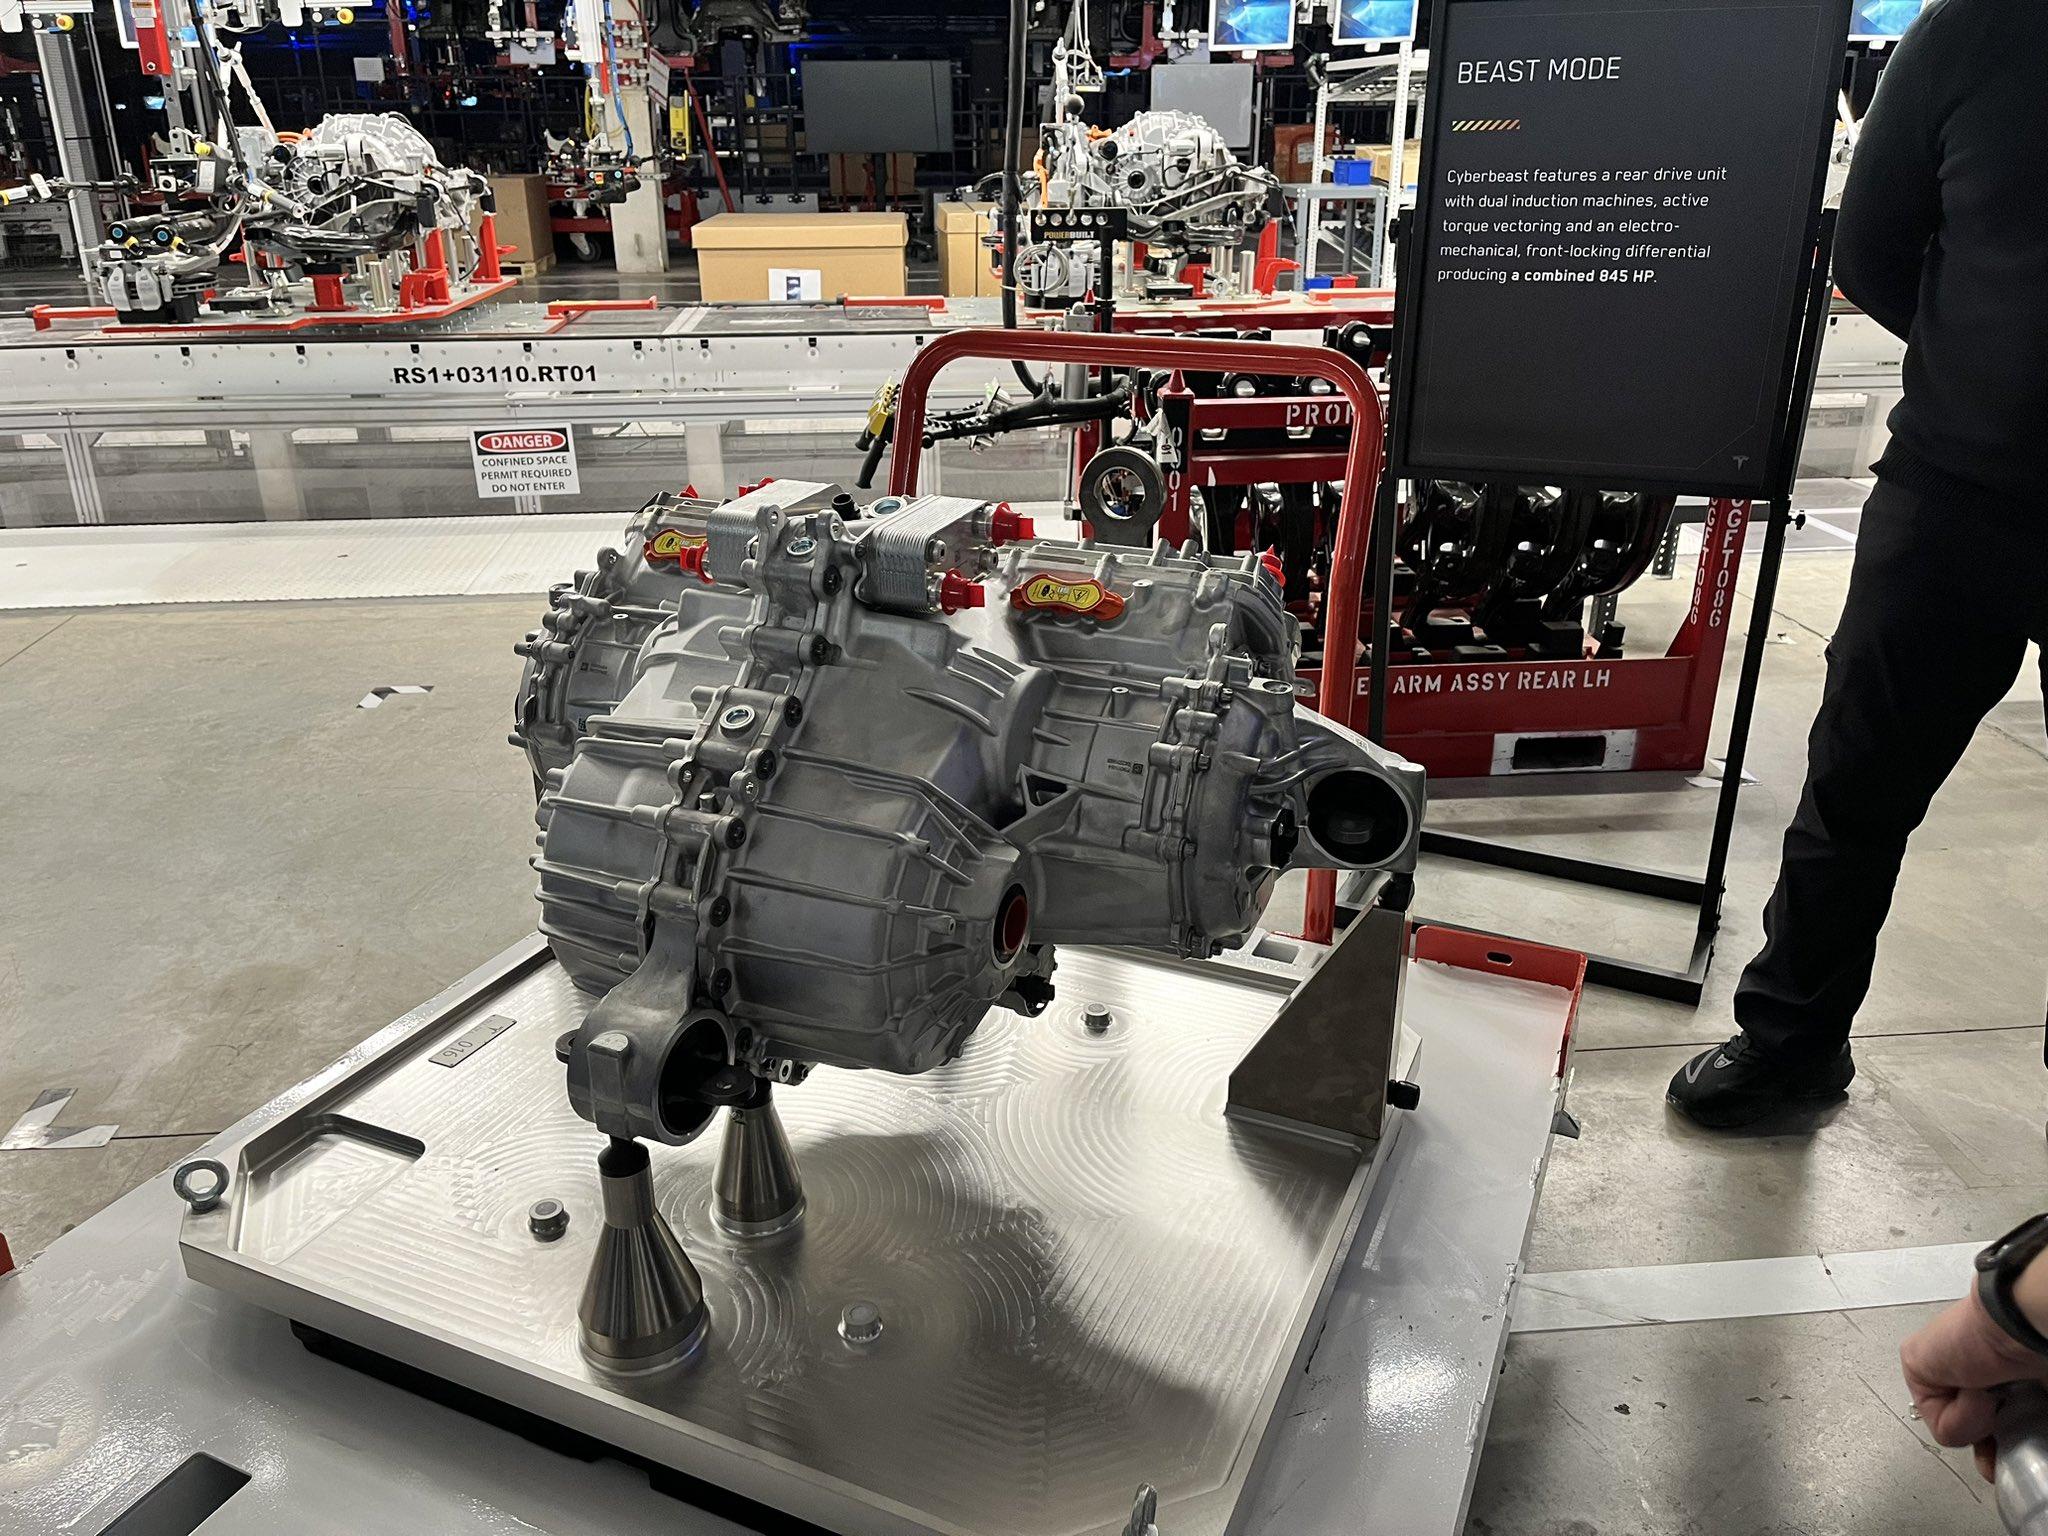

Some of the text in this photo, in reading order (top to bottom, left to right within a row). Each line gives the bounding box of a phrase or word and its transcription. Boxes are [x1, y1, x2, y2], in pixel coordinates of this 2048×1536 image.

[1458, 57, 1621, 83] BEAST MODE
[1448, 167, 1727, 185] Cyberbeast features a rear drive unit
[1445, 193, 1708, 208] with dual induction machines, active
[1043, 230, 1095, 239] POWERBUILT
[1444, 219, 1679, 235] torque vectoring and an electro-
[1441, 244, 1710, 260] mechanical, front-locking differential
[1438, 268, 1656, 283] producing a combined 845 HP.
[393, 365, 597, 384] RS1+03110.RT01
[490, 435, 553, 449] DANGER
[482, 456, 567, 467] CONFINED SPACE
[481, 469, 572, 480] PERMIT REQUIRED
[510, 483, 530, 492] NOT
[534, 482, 565, 490] ENTER
[1393, 669, 1610, 694] ARM ASSY REAR LH
